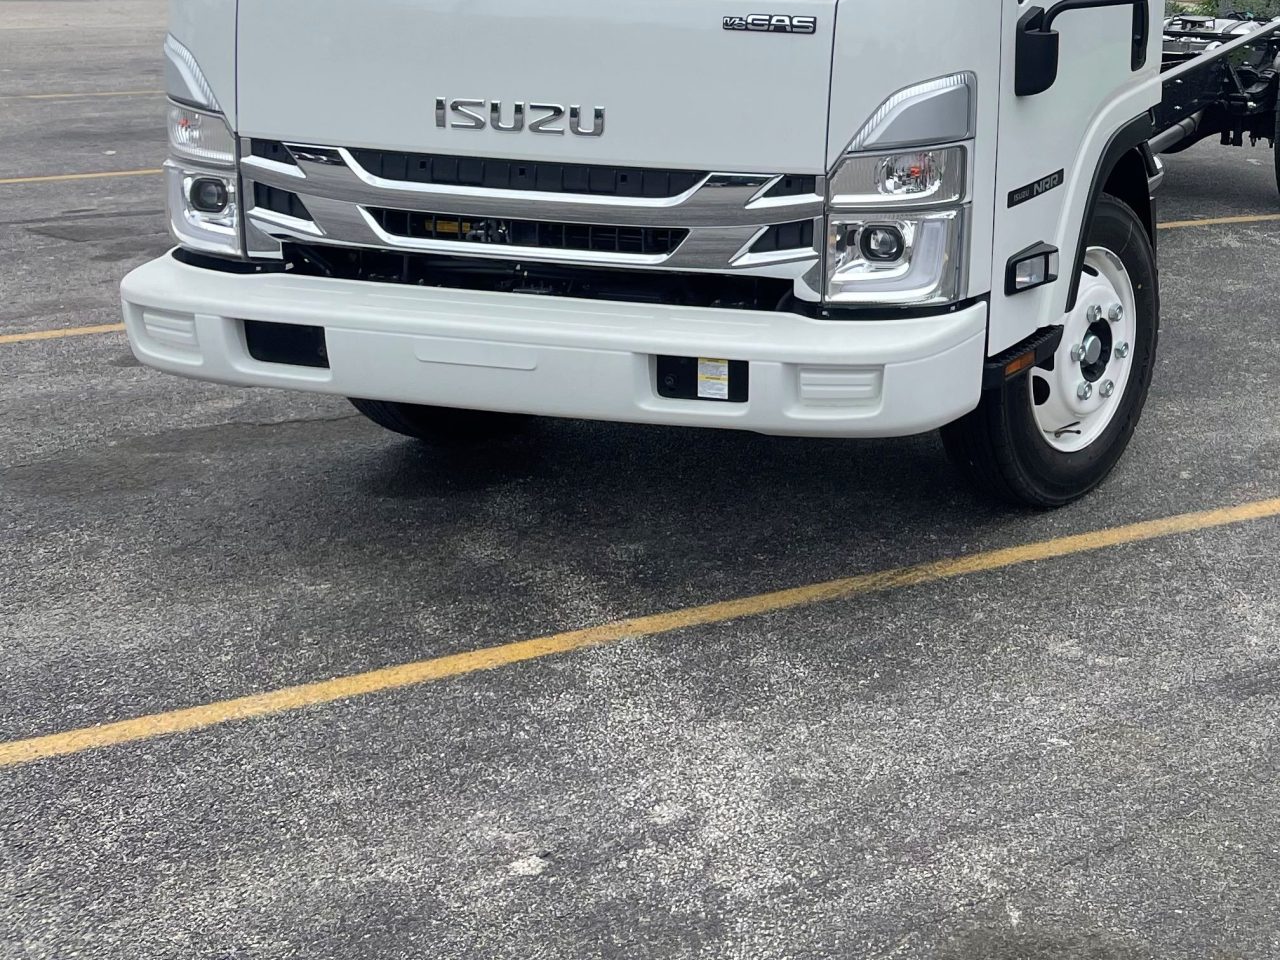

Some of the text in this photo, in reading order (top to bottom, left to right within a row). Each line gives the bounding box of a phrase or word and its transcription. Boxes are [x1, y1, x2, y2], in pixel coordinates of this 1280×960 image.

[747, 14, 816, 33] GAS
[435, 96, 605, 137] ISUZU
[1033, 174, 1059, 195] NRR
